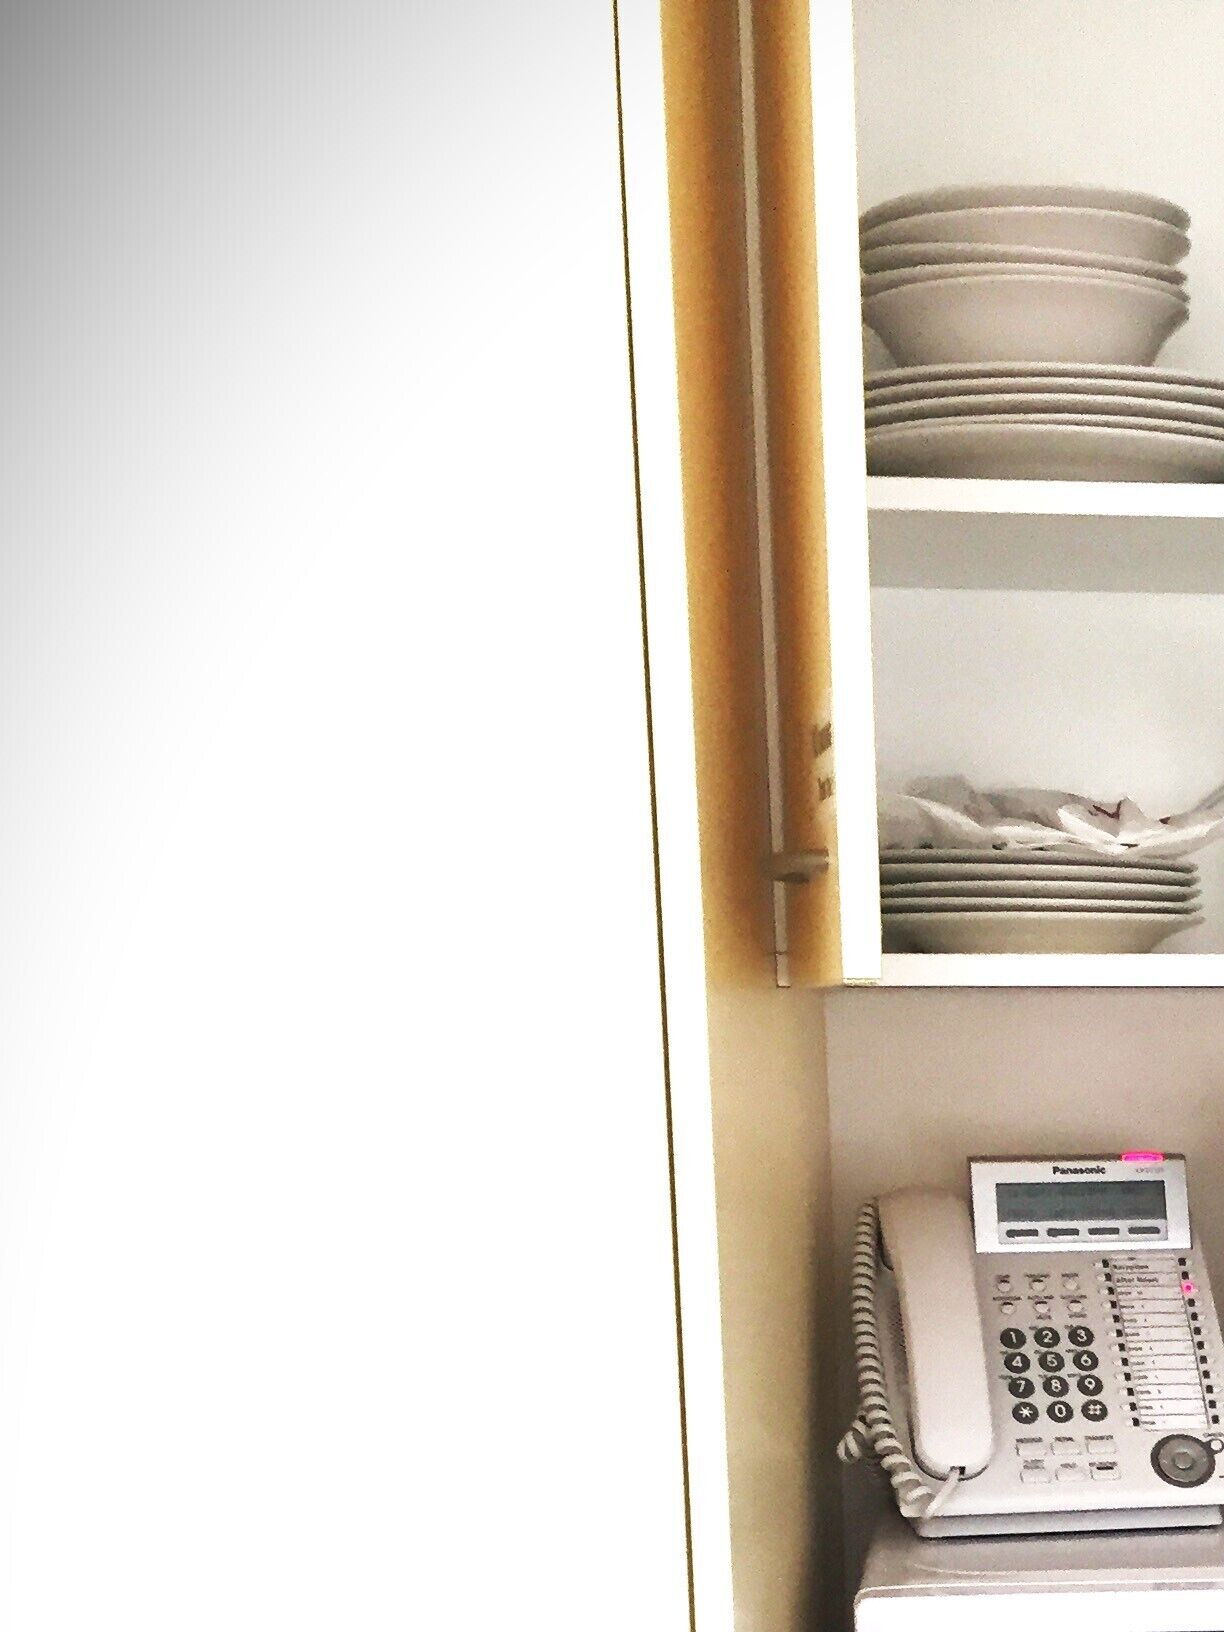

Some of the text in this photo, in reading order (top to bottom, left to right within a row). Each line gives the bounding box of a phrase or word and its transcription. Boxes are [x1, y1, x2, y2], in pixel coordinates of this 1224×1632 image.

[1052, 1166, 1106, 1175] Panasonic
[1010, 1331, 1017, 1344] 1
[1042, 1330, 1053, 1343] 2
[1077, 1328, 1087, 1342] 3
[1011, 1355, 1023, 1367] 4
[1046, 1353, 1058, 1367] 5
[1080, 1353, 1092, 1366] 6
[1016, 1379, 1026, 1393] 7
[1051, 1379, 1061, 1393] 8
[1084, 1377, 1096, 1391] 9
[1054, 1403, 1066, 1418] 0
